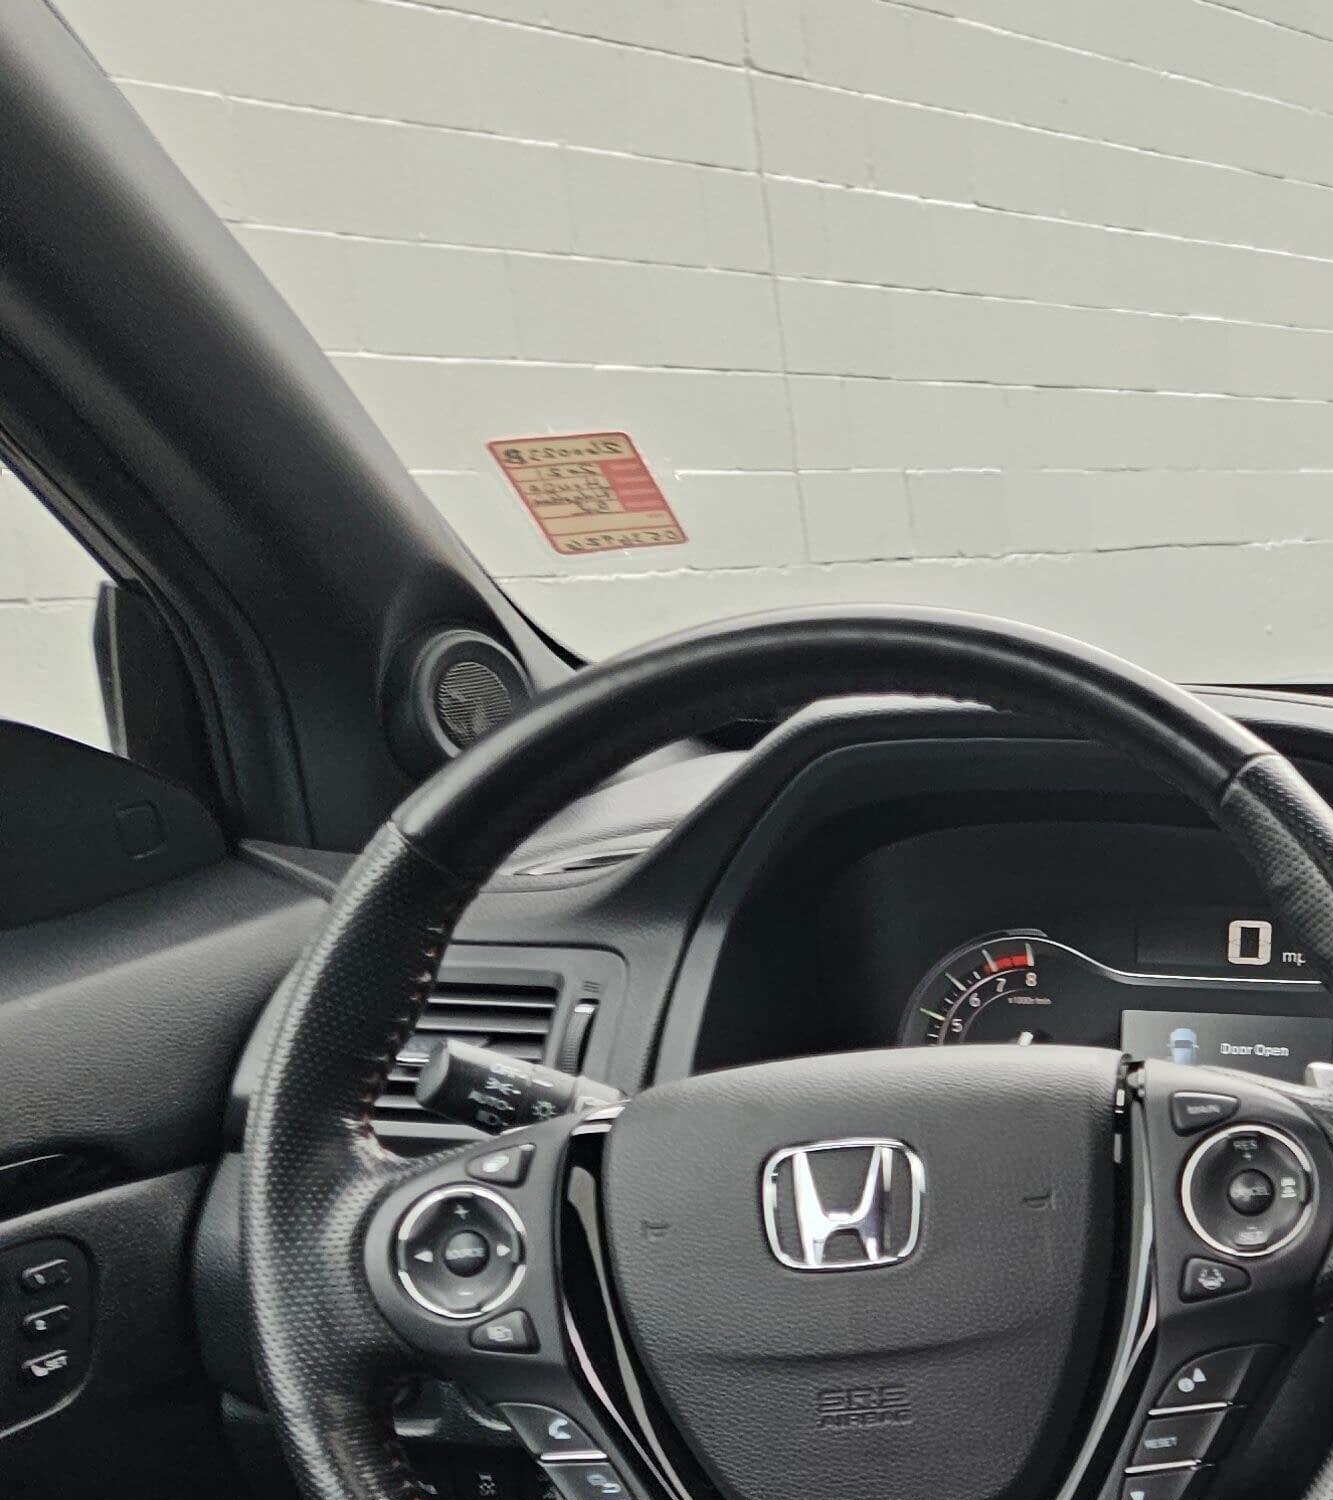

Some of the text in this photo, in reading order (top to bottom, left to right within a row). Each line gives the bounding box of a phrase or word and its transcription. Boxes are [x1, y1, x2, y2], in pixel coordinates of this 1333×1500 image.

[1228, 920, 1272, 965] 0
[1282, 951, 1307, 966] mp
[996, 978, 1006, 992] 7
[1025, 972, 1037, 987] 8
[969, 993, 981, 1007] 6
[951, 1018, 963, 1032] 5
[1220, 1042, 1290, 1057] Door Open
